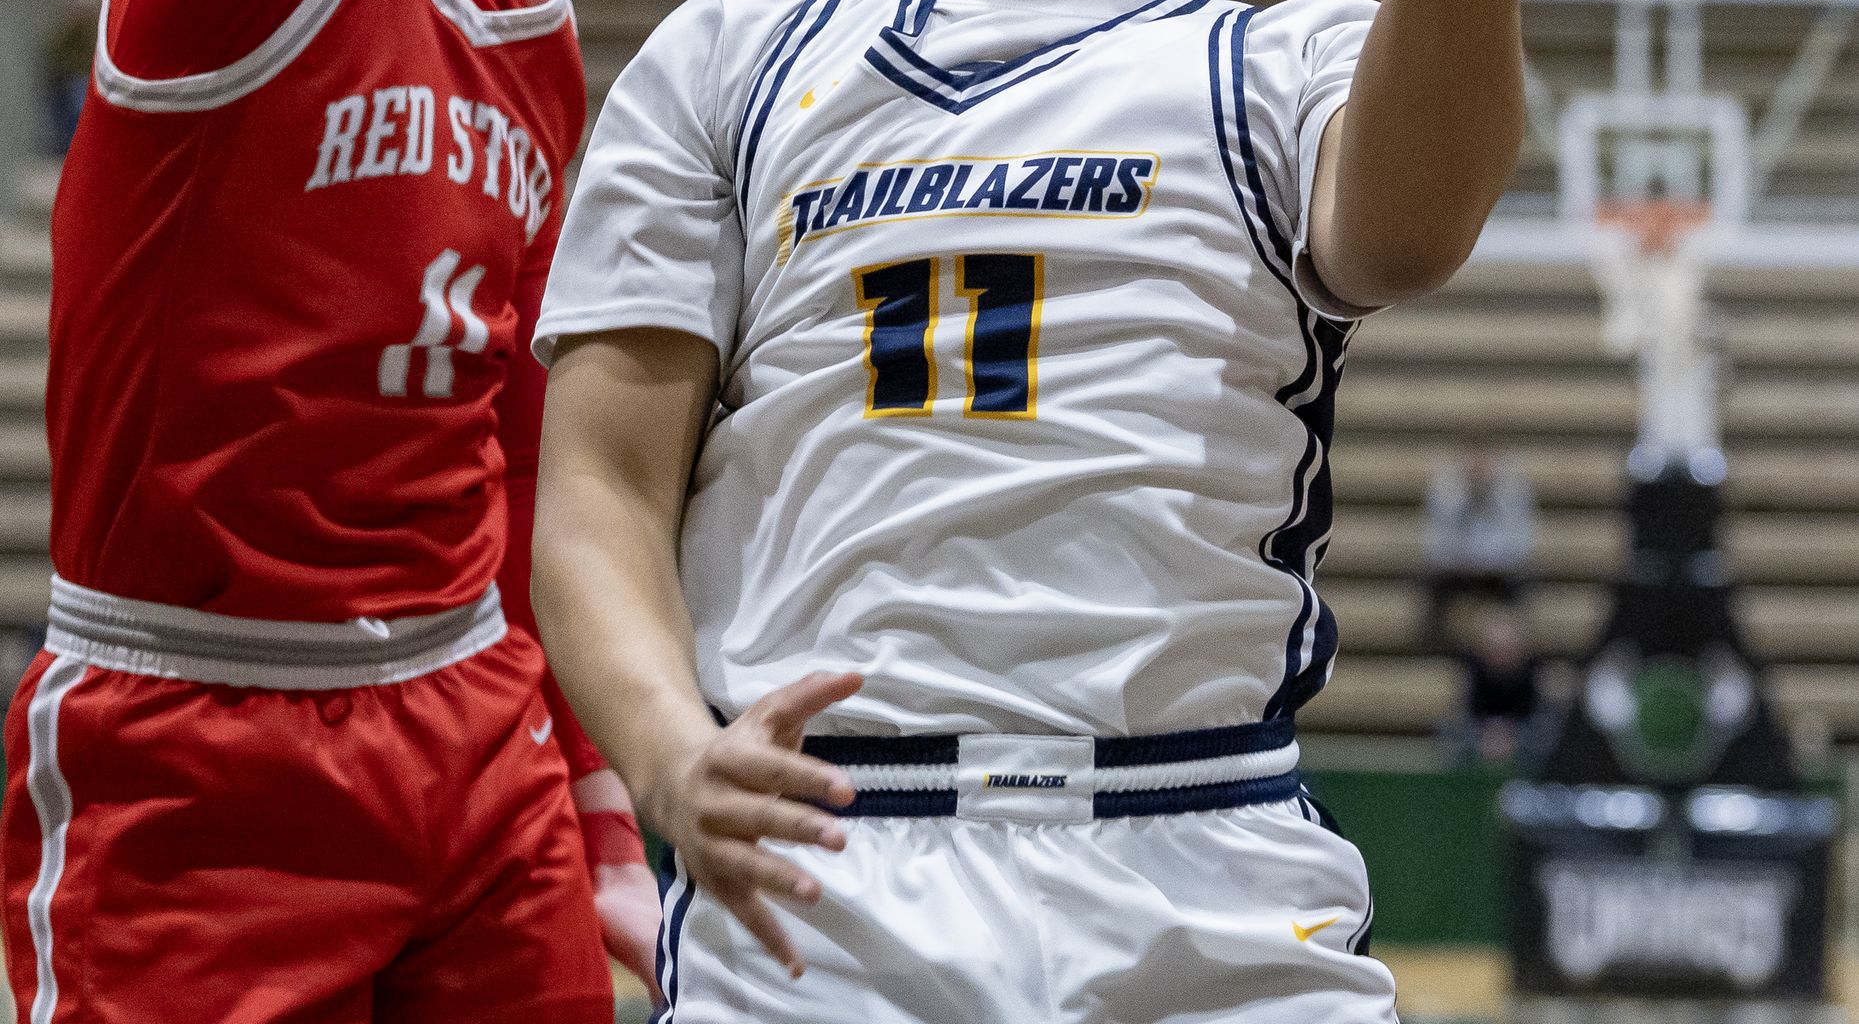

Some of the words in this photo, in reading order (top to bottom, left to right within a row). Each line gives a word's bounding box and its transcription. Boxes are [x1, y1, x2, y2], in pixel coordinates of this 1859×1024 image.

[304, 86, 436, 193] RED
[791, 156, 1154, 250] TRAILBLAZERS
[377, 247, 490, 399] 11
[850, 252, 1045, 420] 11
[987, 774, 1067, 788] TRAILBLAZERS
